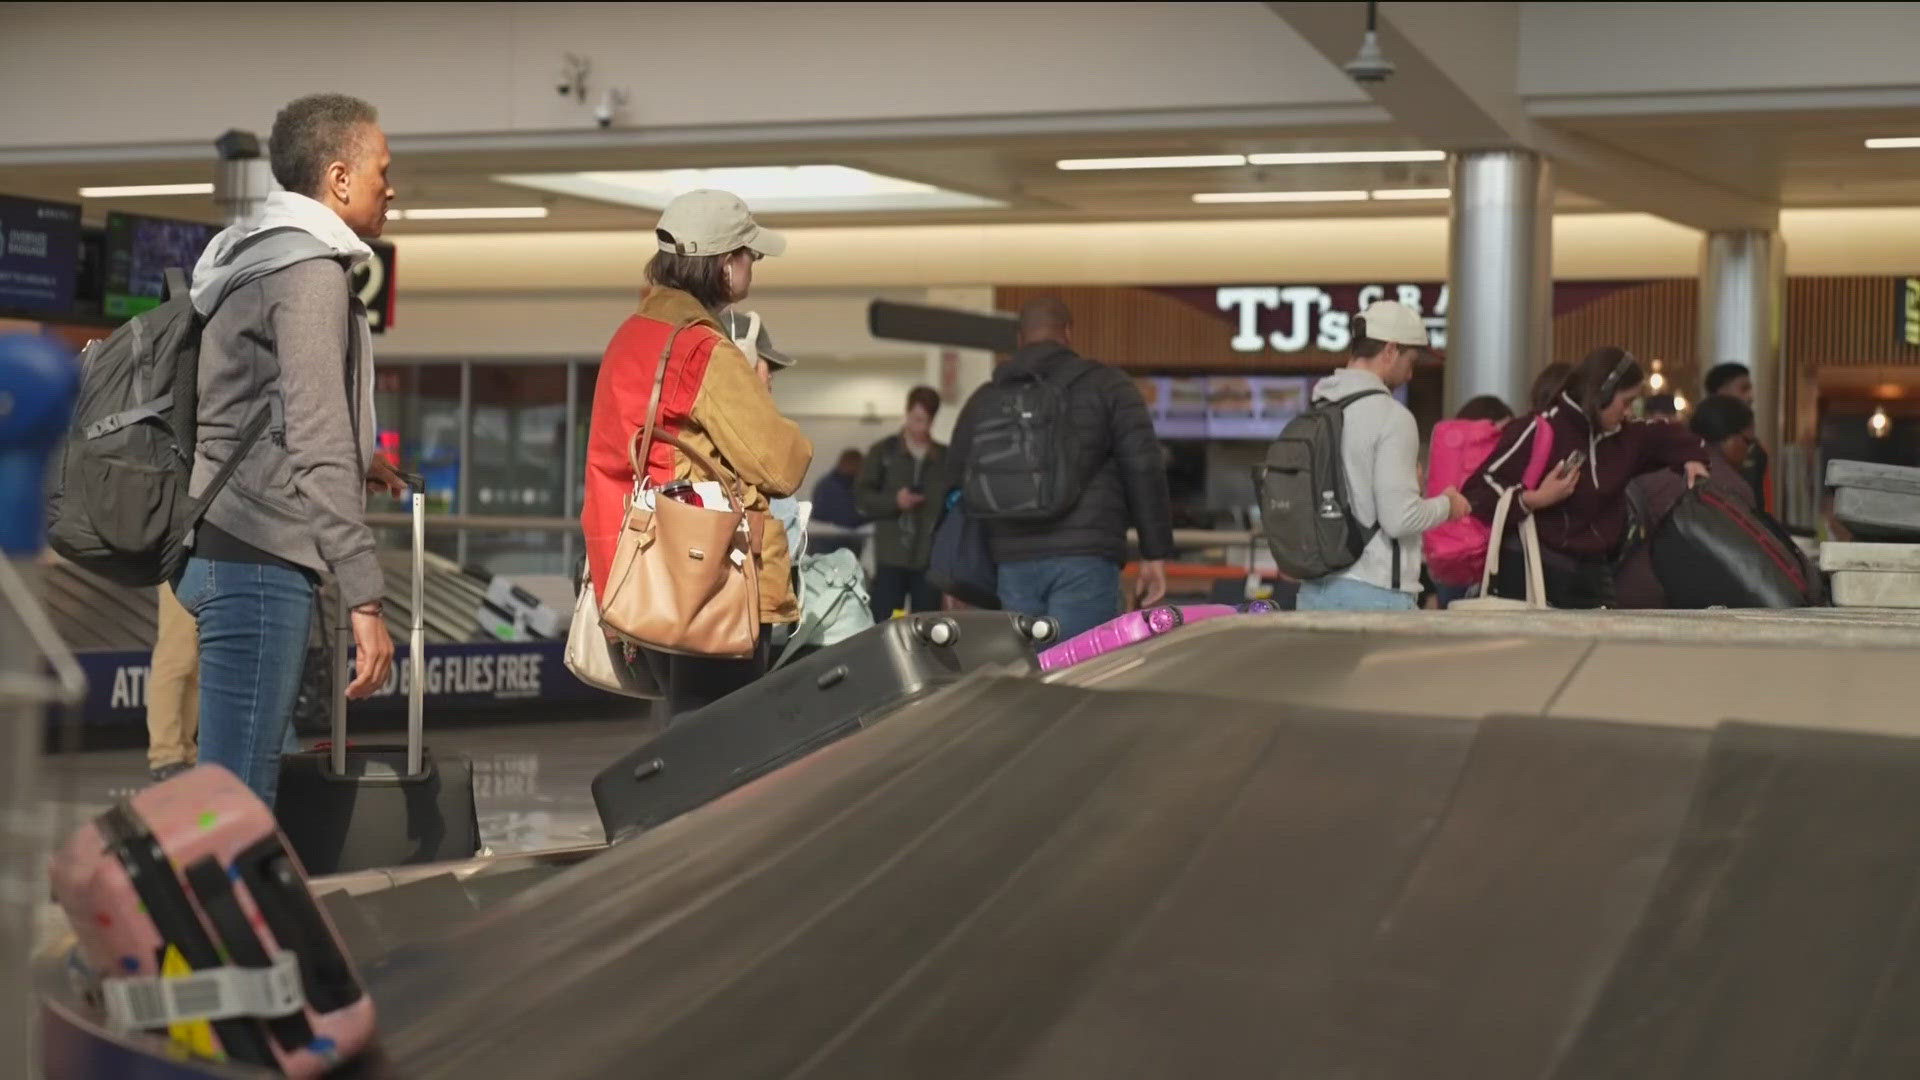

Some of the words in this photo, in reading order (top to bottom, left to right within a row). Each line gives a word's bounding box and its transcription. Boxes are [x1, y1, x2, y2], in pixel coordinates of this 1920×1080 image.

[353, 255, 384, 326] 2
[1217, 287, 1350, 351] TJ's
[401, 657, 442, 694] BG
[444, 657, 494, 693] FLIES
[496, 653, 543, 690] FREE
